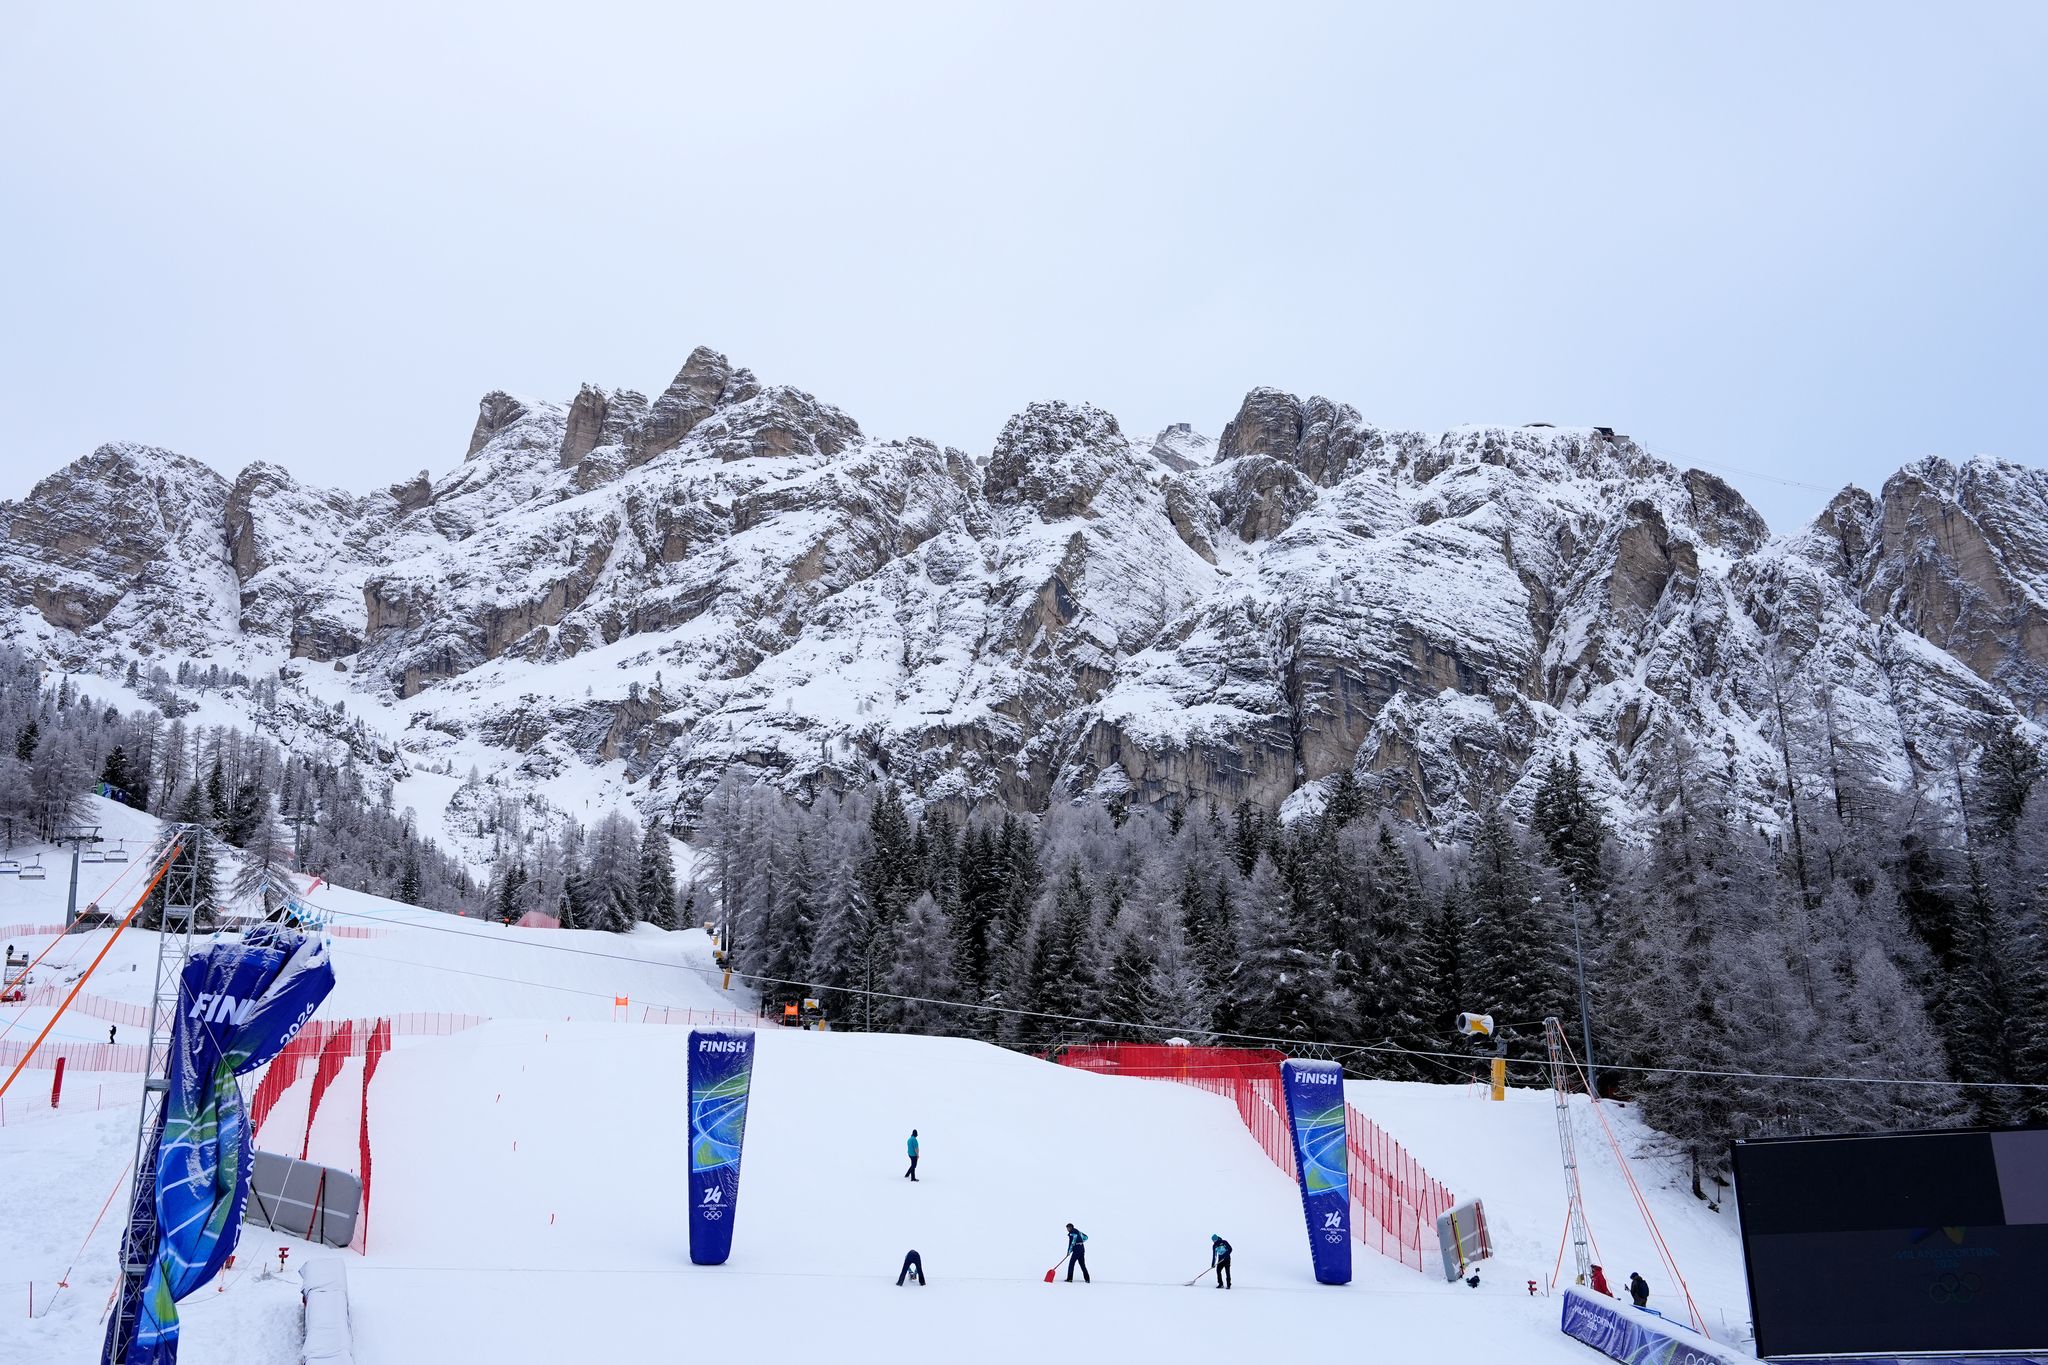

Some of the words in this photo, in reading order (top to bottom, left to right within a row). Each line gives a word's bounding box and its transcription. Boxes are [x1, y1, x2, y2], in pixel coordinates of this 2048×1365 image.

[280, 1002, 314, 1045] 2026
[699, 1040, 747, 1052] FINISH
[1294, 1072, 1338, 1085] FINISH
[1894, 1247, 1942, 1260] MILANO
[1944, 1246, 2000, 1258] CORTINA
